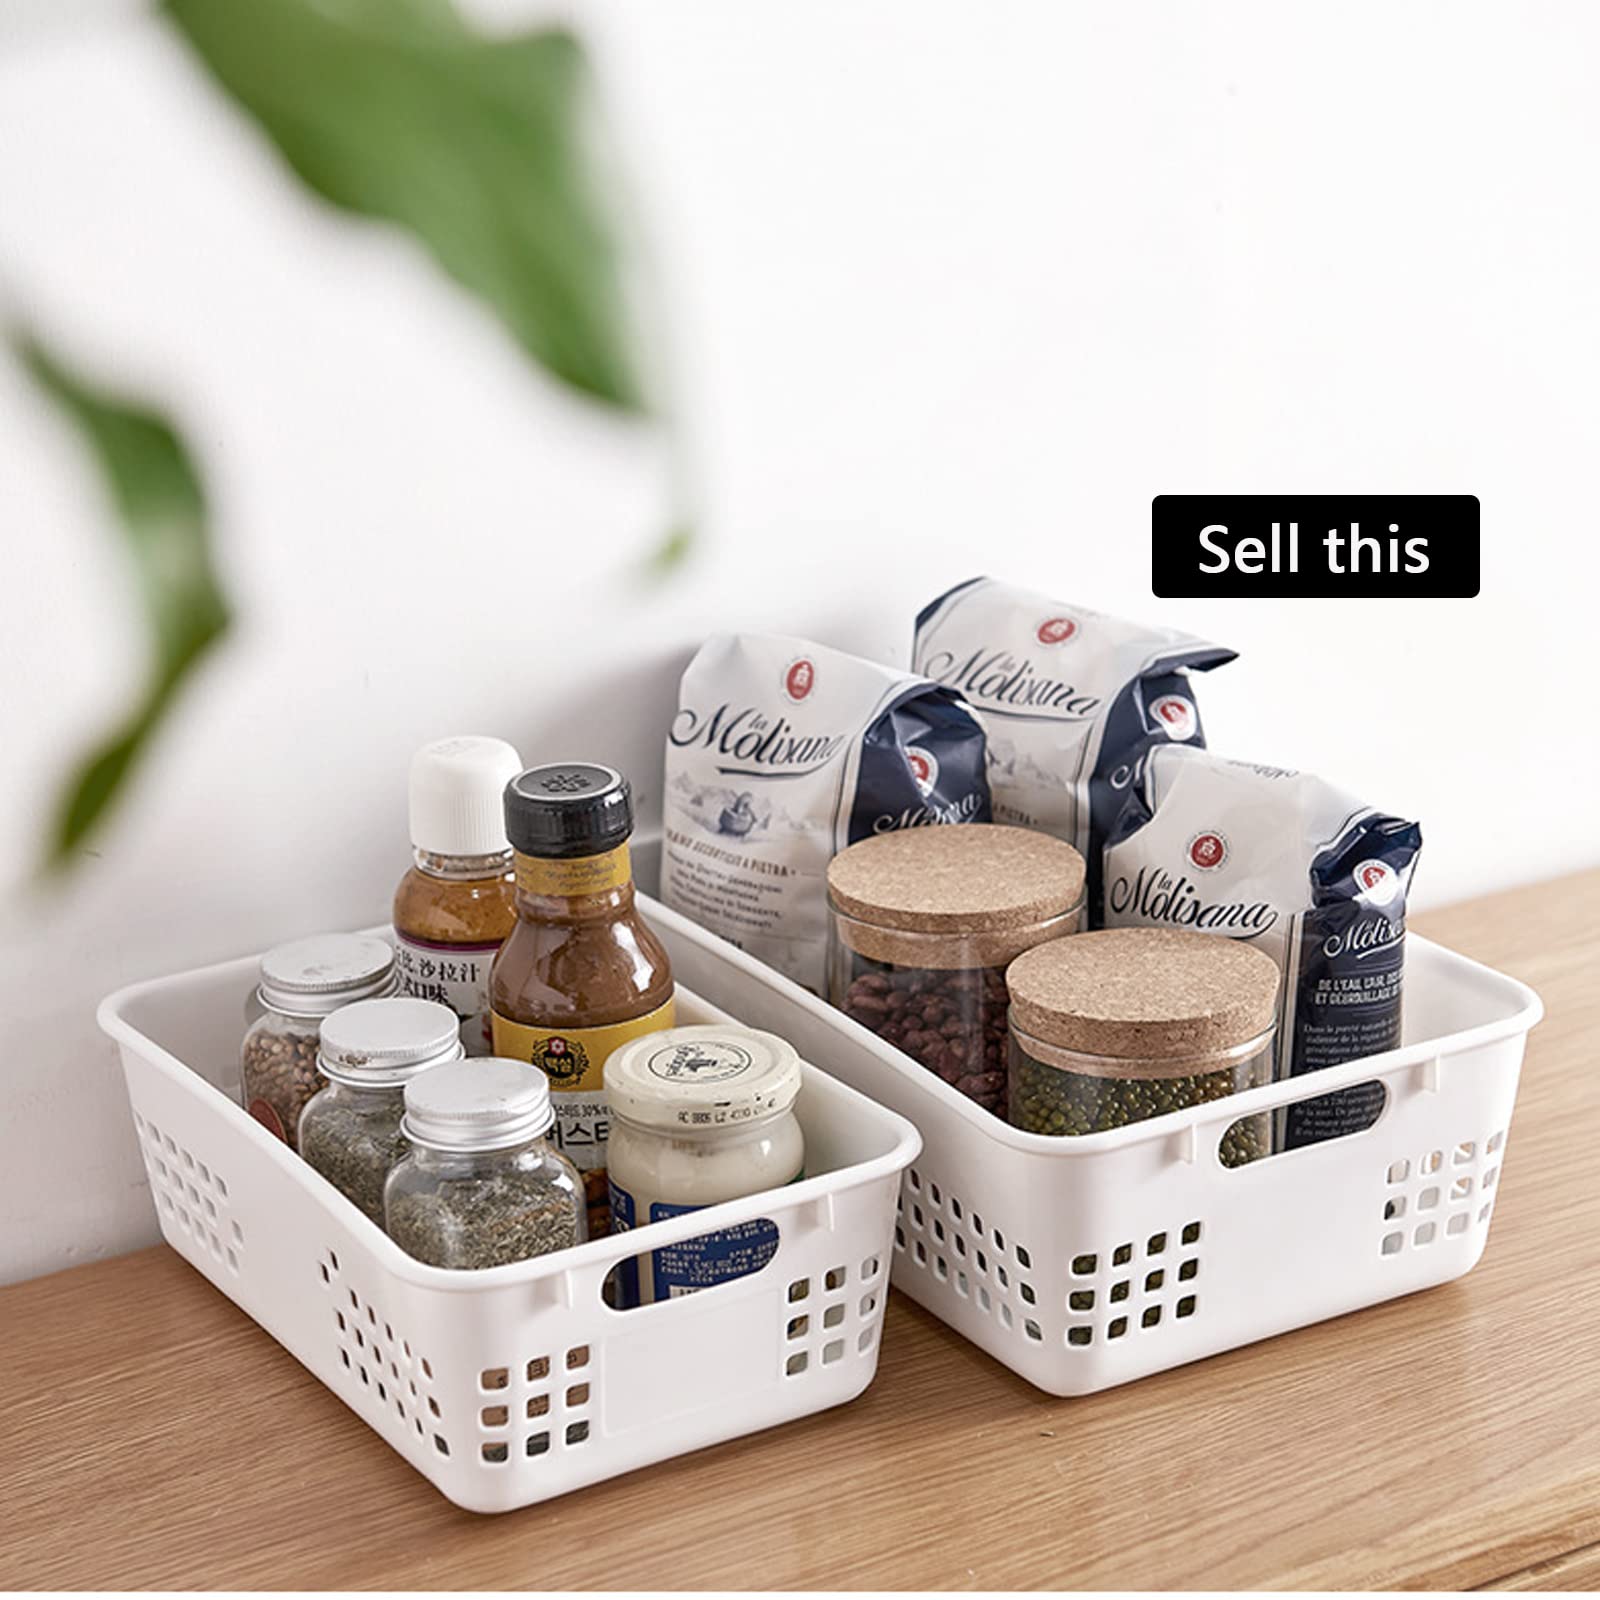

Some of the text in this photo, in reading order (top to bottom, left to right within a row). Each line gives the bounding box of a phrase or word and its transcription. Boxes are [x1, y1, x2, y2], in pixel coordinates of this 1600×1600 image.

[924, 649, 1101, 717] Molisana
[667, 704, 847, 766] Molisana
[1110, 867, 1278, 938] Molisana
